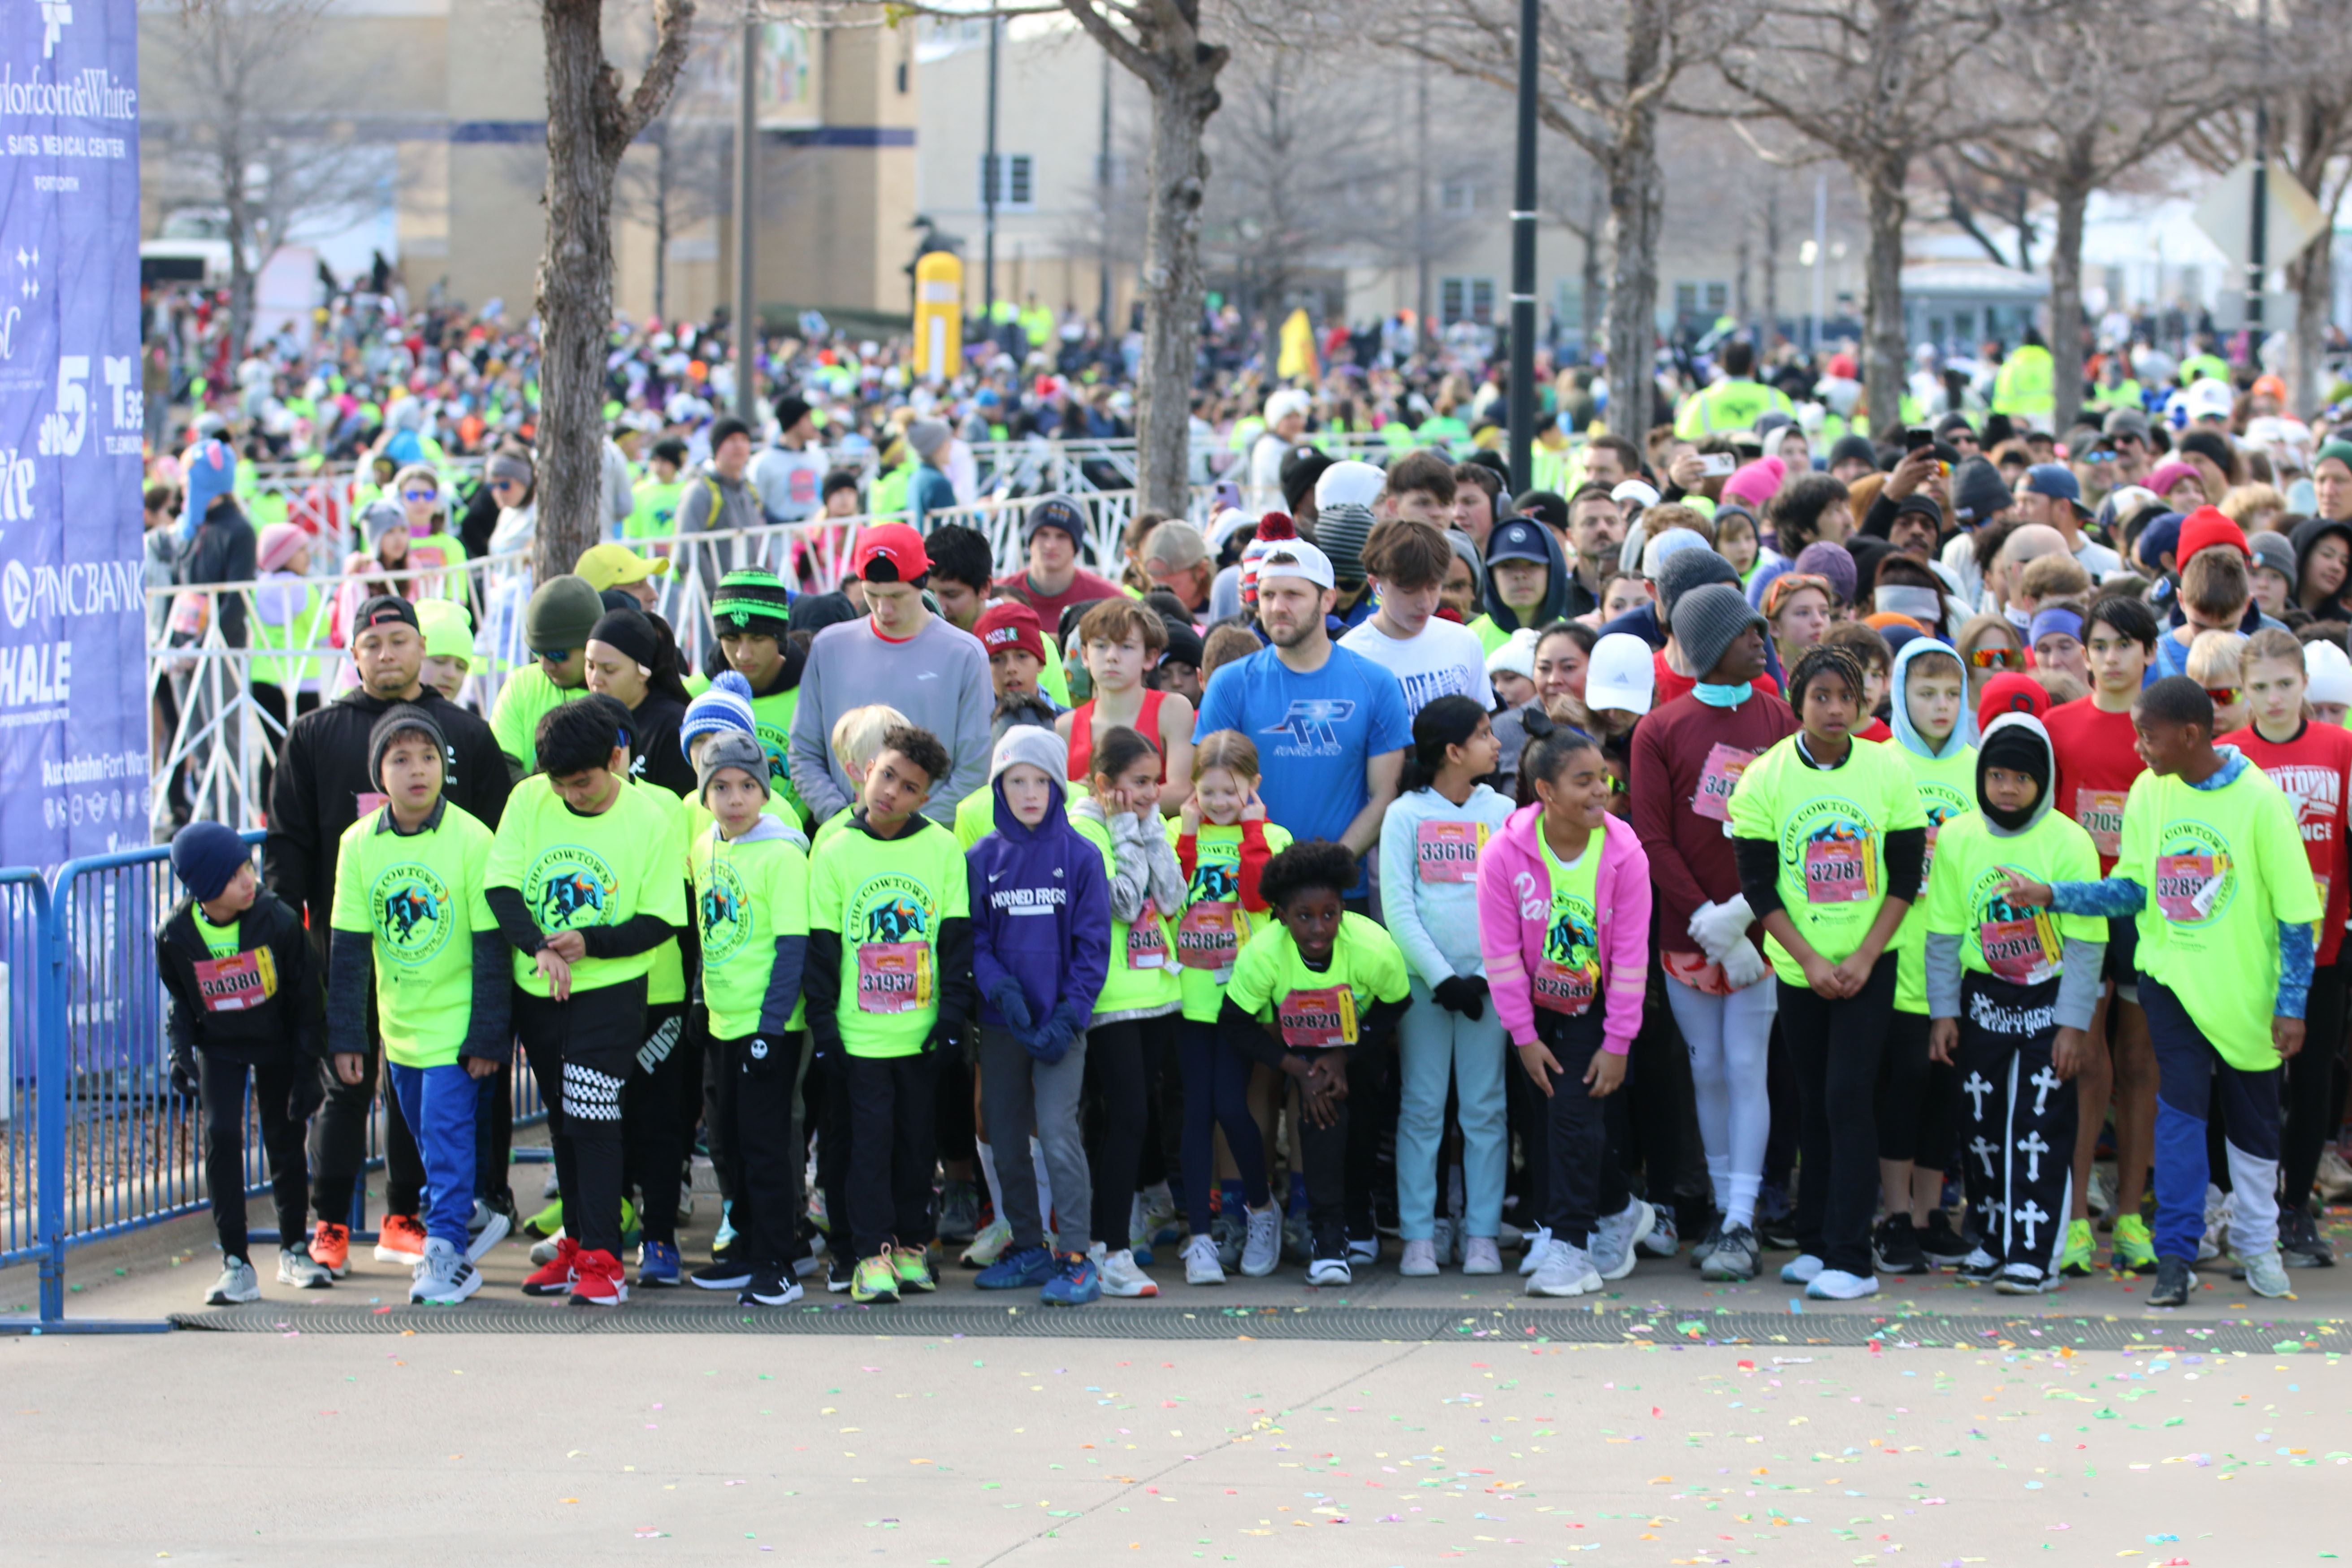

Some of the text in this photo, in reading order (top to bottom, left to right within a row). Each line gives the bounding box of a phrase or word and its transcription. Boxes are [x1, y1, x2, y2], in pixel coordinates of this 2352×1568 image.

[89, 137, 125, 158] CENTER
[1798, 801, 1870, 828] COWTOWN
[1421, 842, 1477, 862] 33616
[528, 849, 612, 893] THE COWTOWN
[1811, 859, 1863, 883] 32787
[373, 866, 444, 916] THE COWTOWN
[990, 888, 1034, 910] HORNED
[850, 876, 931, 931] THE COWTOWN
[1181, 931, 1236, 951] 33862
[1987, 934, 2040, 961] 32814
[203, 970, 260, 996] 34380
[863, 974, 914, 992] 31937
[1282, 1012, 1340, 1029] 32820
